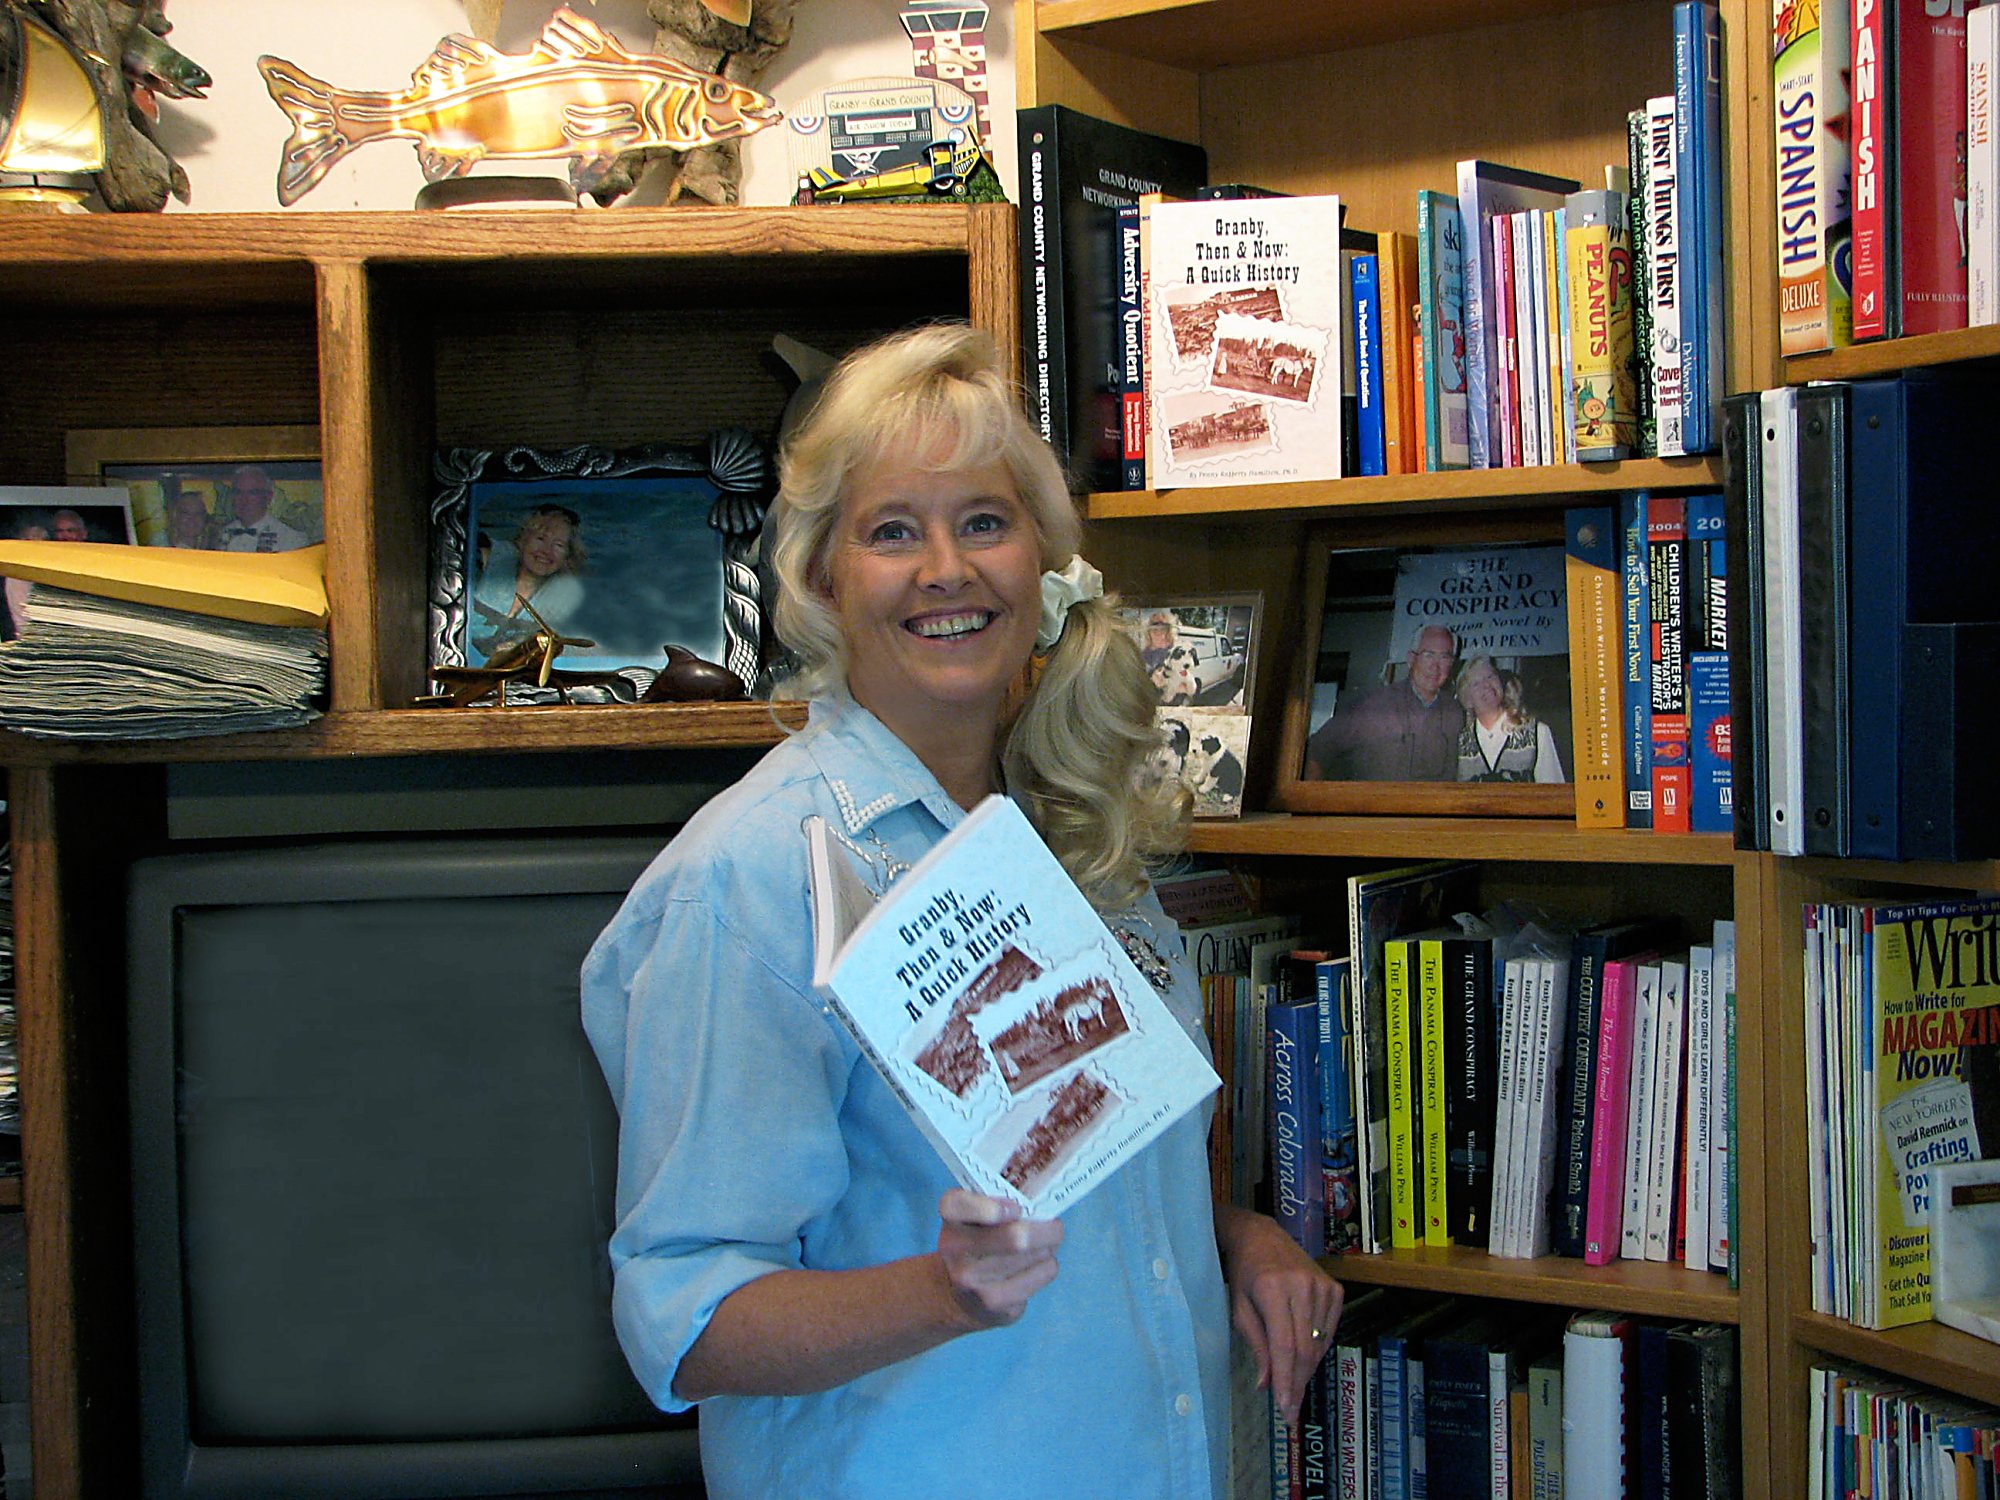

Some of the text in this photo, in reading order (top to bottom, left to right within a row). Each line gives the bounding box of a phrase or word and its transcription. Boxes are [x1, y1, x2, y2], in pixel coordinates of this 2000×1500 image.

[829, 94, 931, 110] GRANBY GRAND COUNTY
[1976, 63, 1988, 144] SPANISH
[1099, 168, 1162, 193] GRAND COUNTY
[1779, 91, 1818, 266] SPANISH
[1215, 217, 1270, 239] Granby,
[1652, 112, 1677, 310] FIRST THINGS FIRST
[1186, 264, 1300, 284] A Quick History
[1196, 240, 1289, 261] Then & Now:
[1031, 152, 1052, 443] GRAND COUNTY NETWORKING DIRECTORY
[1142, 271, 1150, 293] The
[1586, 242, 1608, 357] PEANUTS
[1631, 198, 1646, 359] RICHARD GOSSAGE
[1782, 280, 1820, 313] DELUXE
[1907, 292, 1930, 302] FULLY
[1121, 228, 1141, 385] Adversity Quotient
[1358, 299, 1370, 409] The Pocket Book Quotations
[1468, 322, 1480, 369] Women
[1507, 338, 1515, 371] Prevention
[1682, 357, 1693, 418] Wayne Dyer
[1648, 523, 1681, 531] 2004
[1440, 573, 1533, 594] GRAND
[1469, 557, 1509, 573] THE
[1406, 589, 1565, 617] CONSPIRACY
[1493, 615, 1554, 628] Novel By
[1626, 528, 1641, 682] How to Sell Your First Novel
[1668, 543, 1682, 710] CHILDREN'S WRITER'S &
[1710, 577, 1727, 651] MARKET
[1500, 634, 1541, 647] PENN
[1594, 575, 1609, 767] Christian Writers' Market Guide
[1651, 663, 1663, 711] MARKET
[1661, 622, 1672, 710] ILLUSTRATOR'S
[1635, 741, 1643, 775] Leighton
[898, 888, 966, 947] Granby,
[1887, 905, 1957, 919] Top 11 Tips for
[896, 889, 1002, 989] Then & Now:
[905, 902, 1032, 1023] A Quick History
[1318, 976, 1331, 1043] COLORADO TRIVIA
[1465, 953, 1476, 1101] THE GRAND CONSPIRACY
[1603, 1017, 1614, 1033] The
[1884, 991, 1966, 1016] How to Write for
[1390, 960, 1404, 1112] THE PANAMA CONSPIRACY
[1425, 958, 1438, 1111] THE PANAMA CONSPIRACY
[1573, 956, 1593, 1116] THE COUNTRY CONSULTANT
[1601, 1034, 1613, 1062] Lonely
[1640, 1018, 1649, 1040] WORLD
[1665, 1021, 1674, 1043] WORLD
[1882, 1004, 2000, 1057] MAGAZIN
[1274, 1028, 1295, 1105] Across
[1599, 1062, 1612, 1102] Mermaid
[1699, 969, 1709, 1153] BOYS AND GIRLS LEARN DIFFERENTLY!
[1896, 1046, 1965, 1082] Now!
[1572, 1118, 1585, 1151] Brian
[1889, 1114, 1913, 1132] NEW
[1897, 1117, 1969, 1149] David Remnick on
[1055, 1148, 1118, 1201] By Penny Rafferty
[1277, 1111, 1305, 1217] Colorado
[1396, 1134, 1405, 1205] WILLIAM PENN
[1430, 1132, 1439, 1202] WILLIAM PENN
[1466, 1130, 1475, 1186] William Penn
[1905, 1136, 1969, 1170] Crafting
[1568, 1161, 1582, 1195] Smith
[1889, 1233, 1925, 1251] Discover
[1889, 1251, 1925, 1269] Magazine
[1889, 1276, 1915, 1292] Get the
[1889, 1292, 1921, 1309] That Sell
[1341, 1357, 1358, 1500] THE BEGINNING WRITERS
[1369, 1383, 1379, 1467] FROM PRINTOUT TO
[1493, 1398, 1508, 1497] Survival in the
[1292, 1442, 1300, 1485] Manual
[1304, 1424, 1324, 1489] NOVEL
[1661, 1418, 1671, 1484] ALEXANDER
